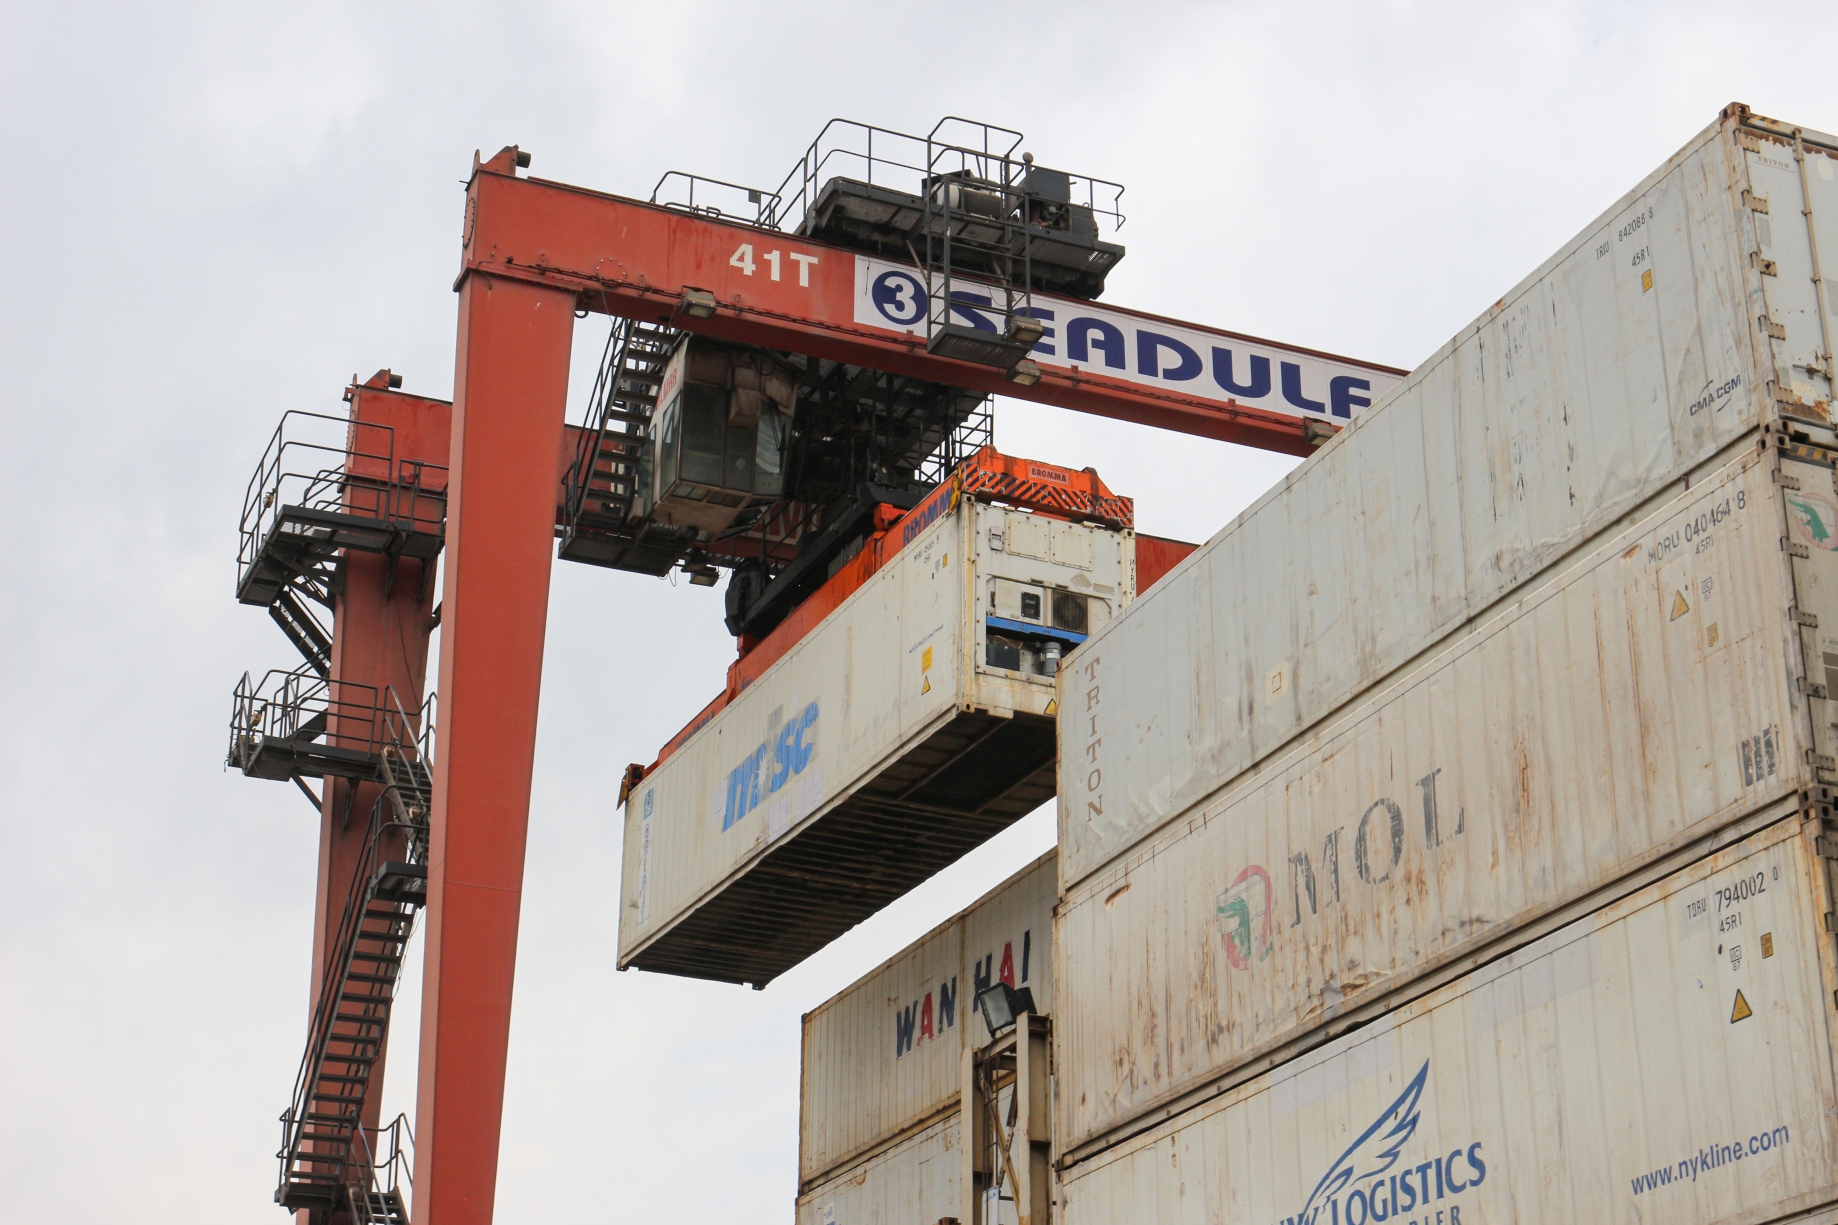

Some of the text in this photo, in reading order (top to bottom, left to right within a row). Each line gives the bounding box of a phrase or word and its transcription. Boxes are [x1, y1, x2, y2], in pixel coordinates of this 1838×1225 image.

[1757, 156, 1789, 169] TRITON
[1618, 213, 1646, 242] 842088
[1648, 206, 1654, 219] 8
[729, 243, 818, 288] 41T
[1632, 246, 1650, 267] 45R1
[1690, 374, 1742, 417] CMA CGM
[1031, 467, 1067, 483] BROMMA
[903, 488, 952, 548] BROMM
[1648, 490, 1746, 565] MORU 040464 8
[1085, 656, 1104, 823] TRITON
[1288, 767, 1465, 929] MOL
[1715, 872, 1766, 912] 794002
[1720, 912, 1742, 933] 45R1
[896, 929, 1031, 1060] WAN HAI
[1631, 1123, 1790, 1196] www.nykline.com
